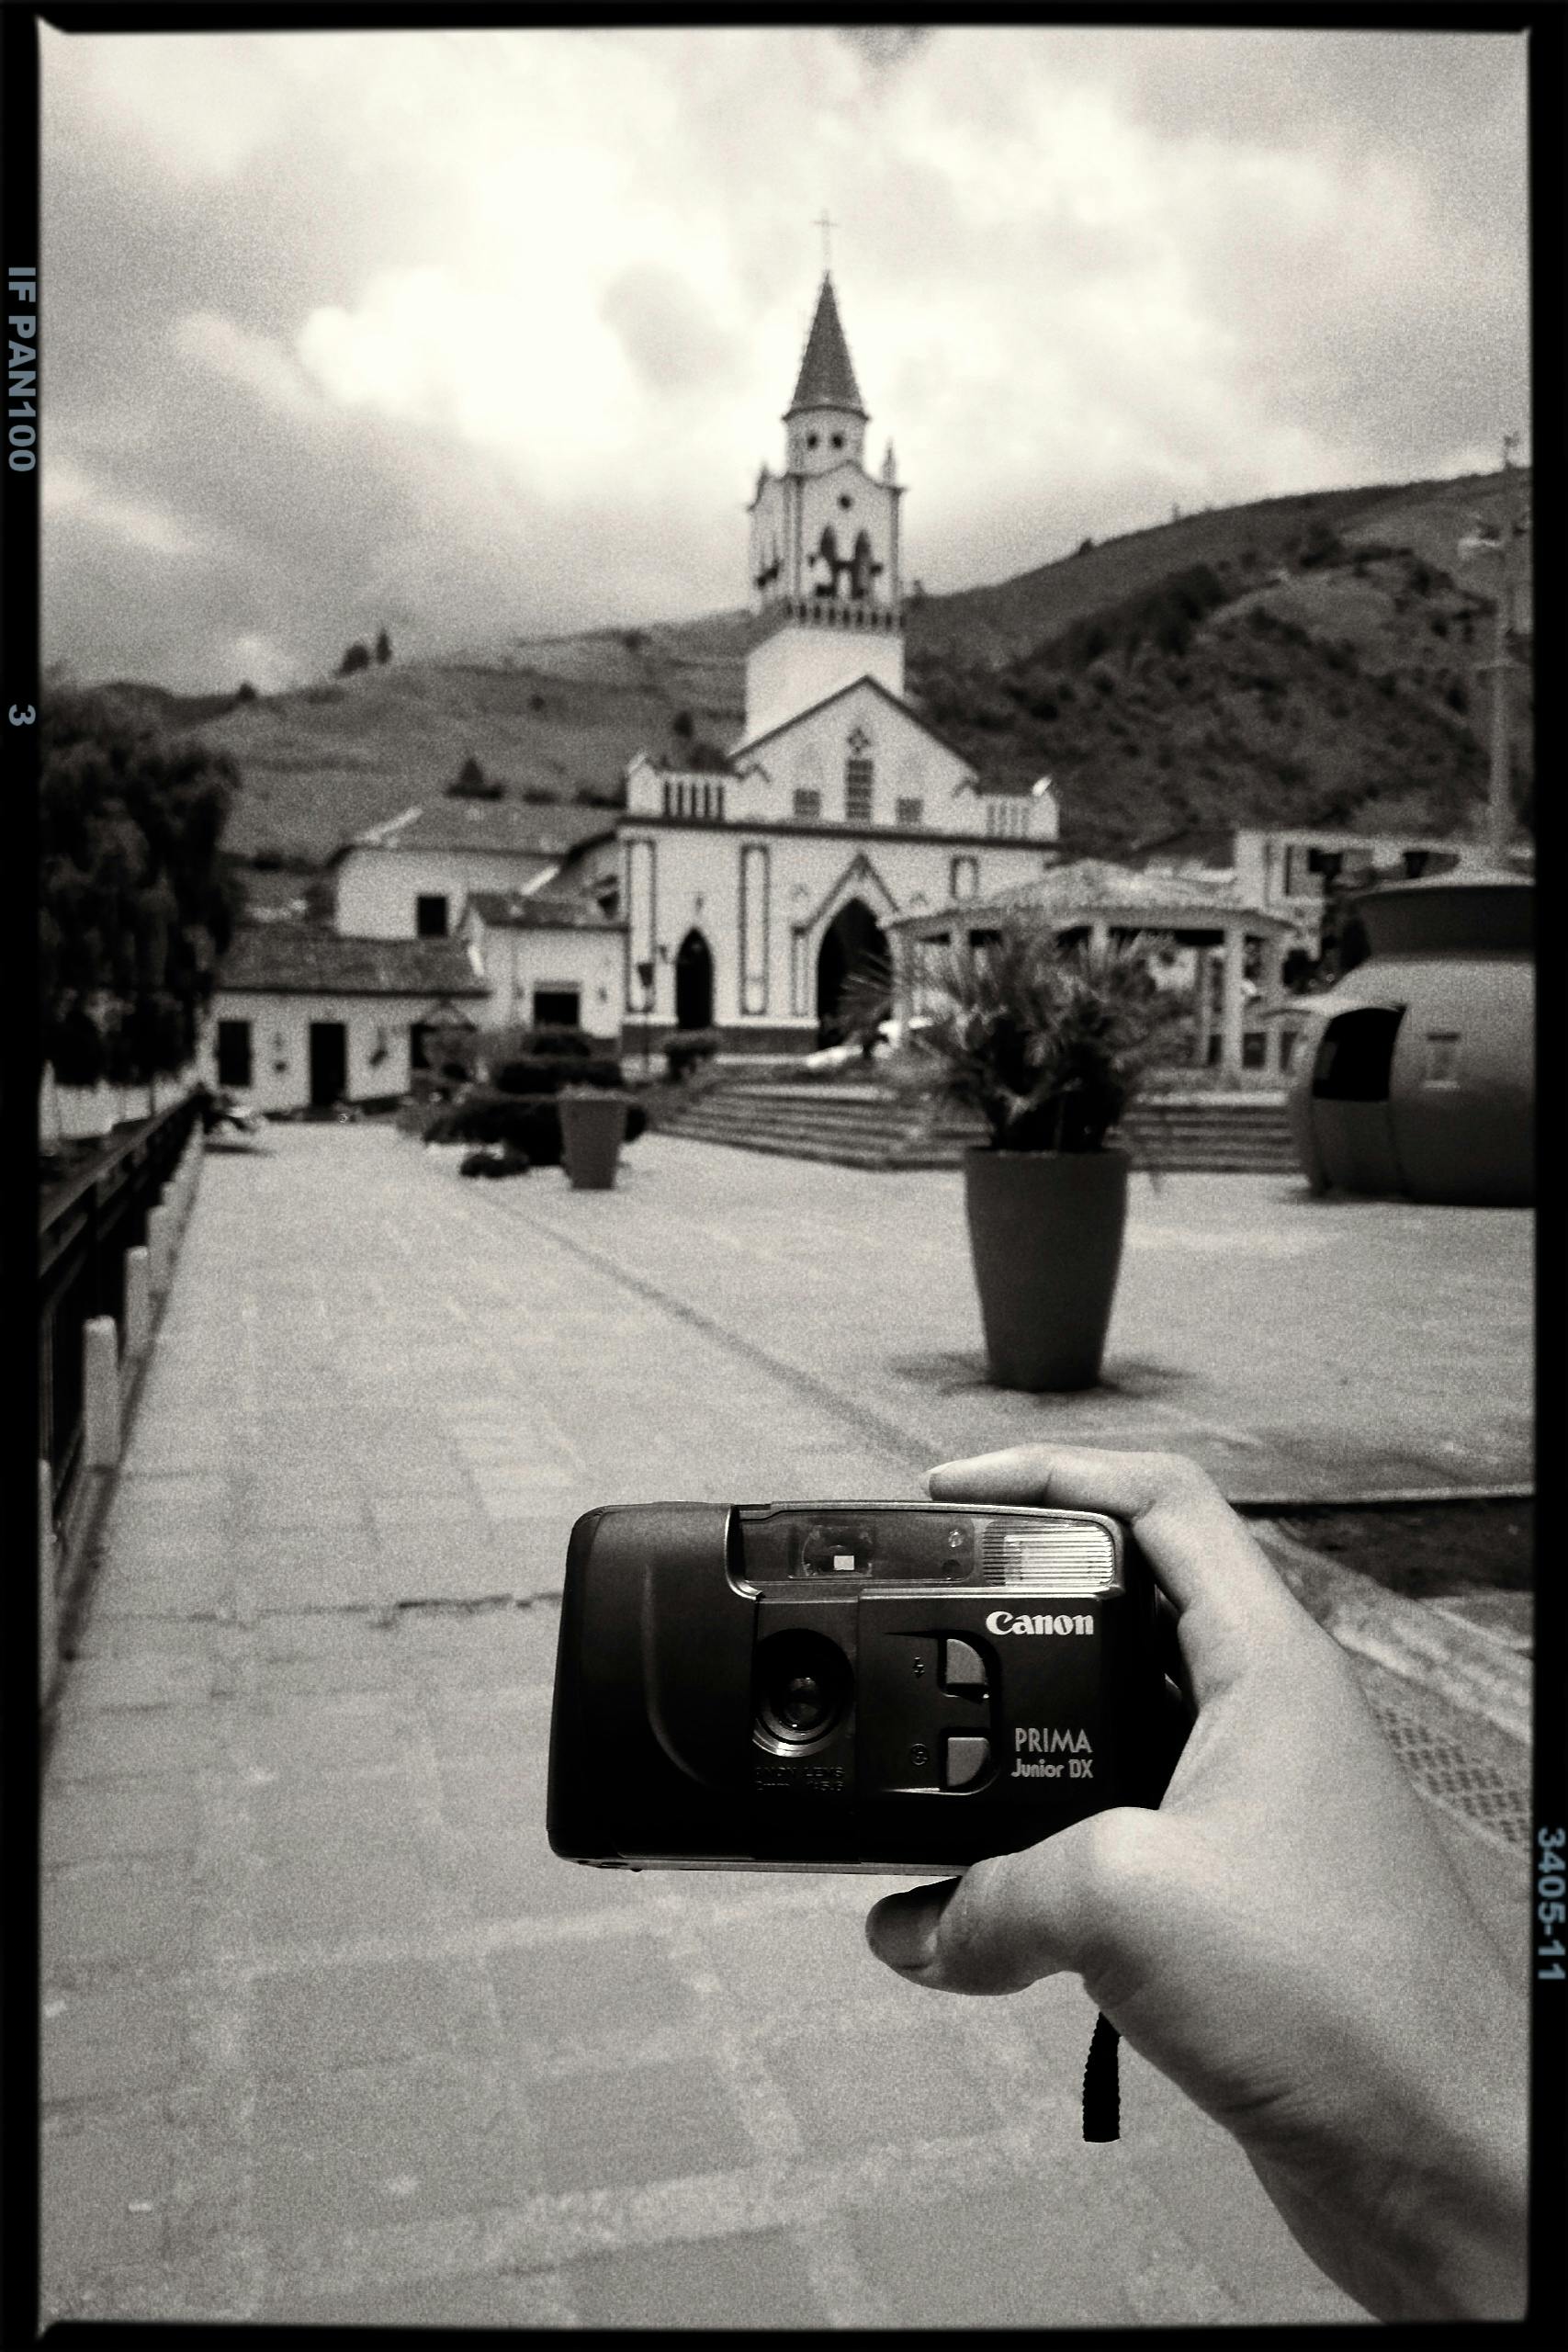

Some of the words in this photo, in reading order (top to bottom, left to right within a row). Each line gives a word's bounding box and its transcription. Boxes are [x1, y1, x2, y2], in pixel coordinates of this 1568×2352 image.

[986, 1611, 1094, 1636] Canon
[1015, 1727, 1093, 1753] PRIMA
[1010, 1758, 1065, 1778] Junior
[1068, 1758, 1093, 1778] DX
